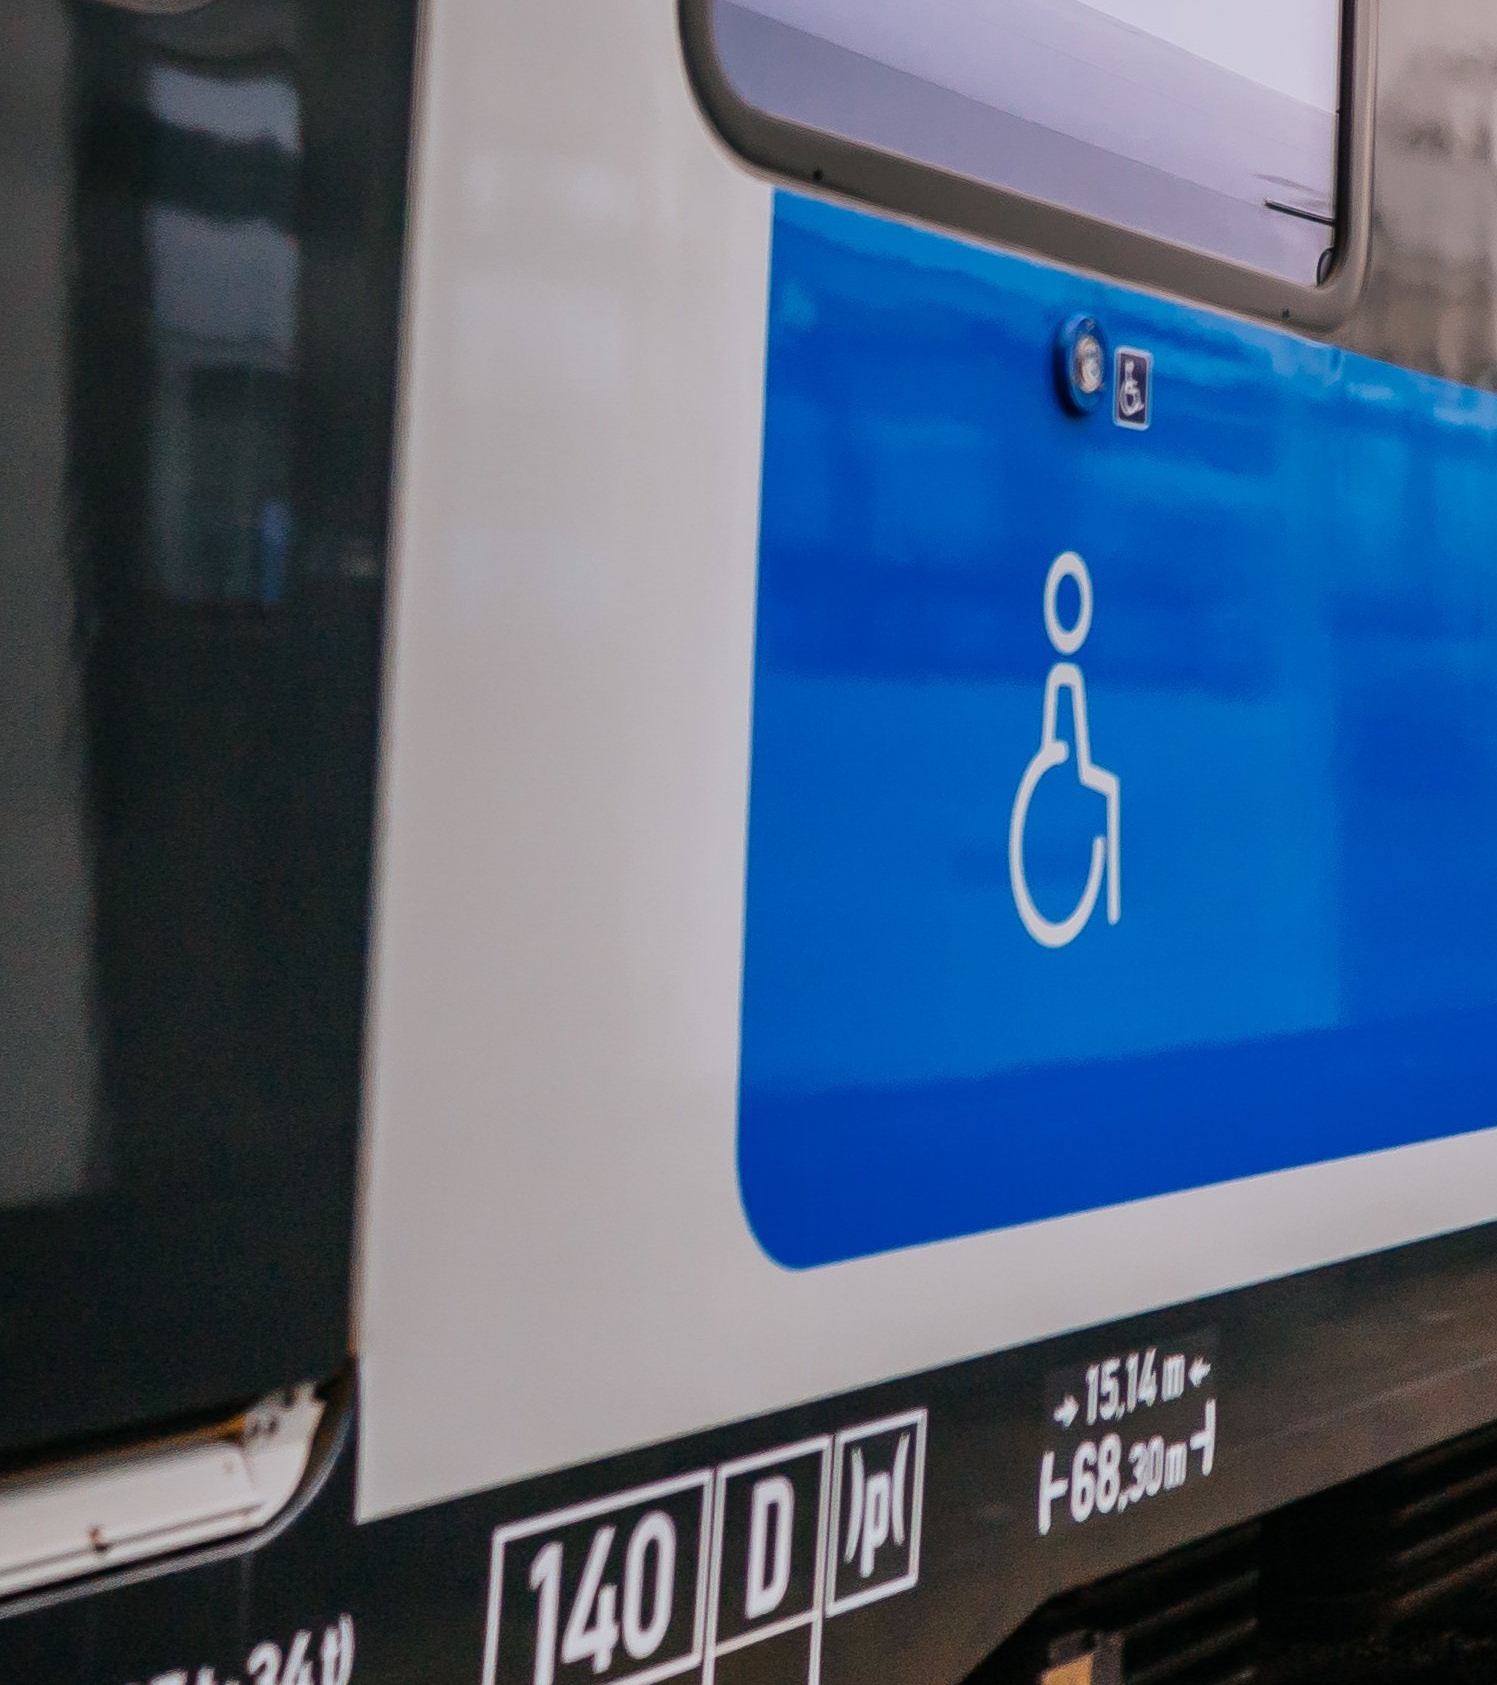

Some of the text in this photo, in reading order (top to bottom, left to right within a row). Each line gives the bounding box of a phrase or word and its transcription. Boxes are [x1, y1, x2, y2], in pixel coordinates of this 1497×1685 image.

[1086, 1348, 1185, 1426] 15,14 m
[530, 1510, 677, 1685] 140
[744, 1475, 795, 1620] D
